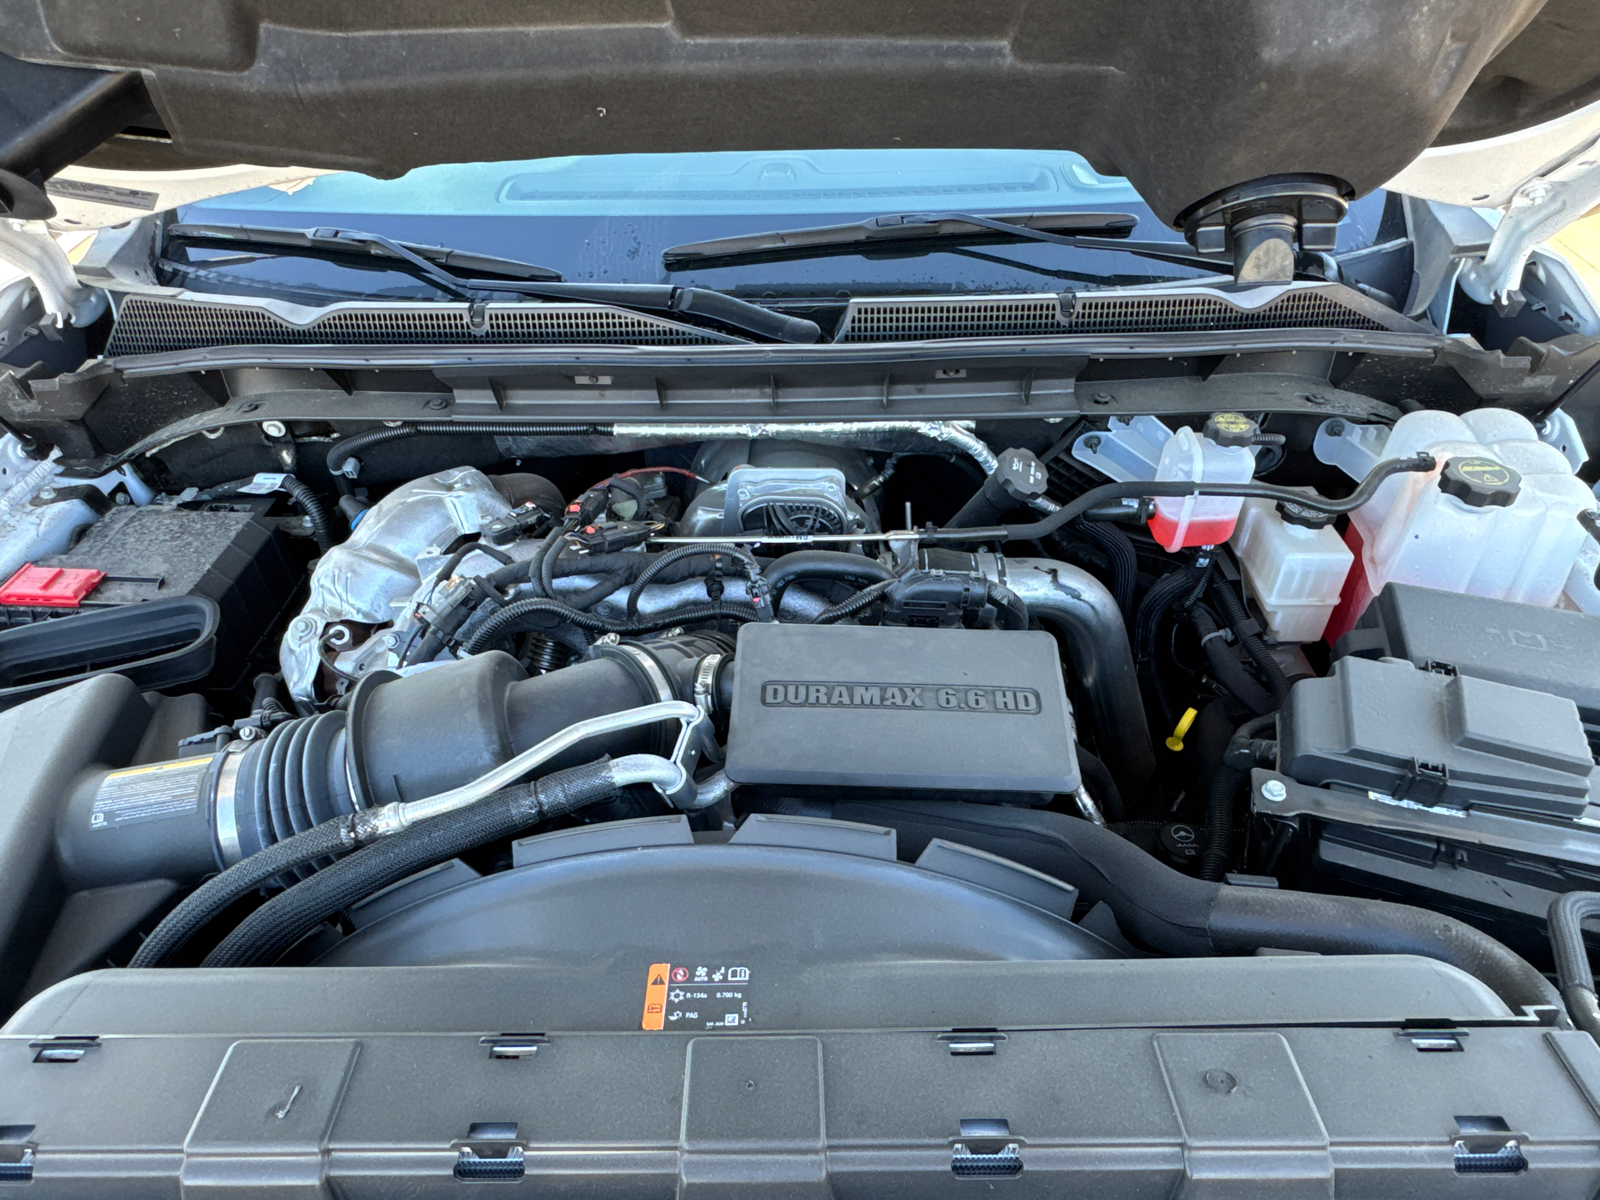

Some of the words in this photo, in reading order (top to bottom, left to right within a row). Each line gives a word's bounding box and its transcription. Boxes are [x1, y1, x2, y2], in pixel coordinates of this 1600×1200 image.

[764, 684, 924, 708] DURAMAX
[936, 688, 988, 710] 6.6
[994, 690, 1038, 712] HD
[685, 1011, 699, 1019] PAG
